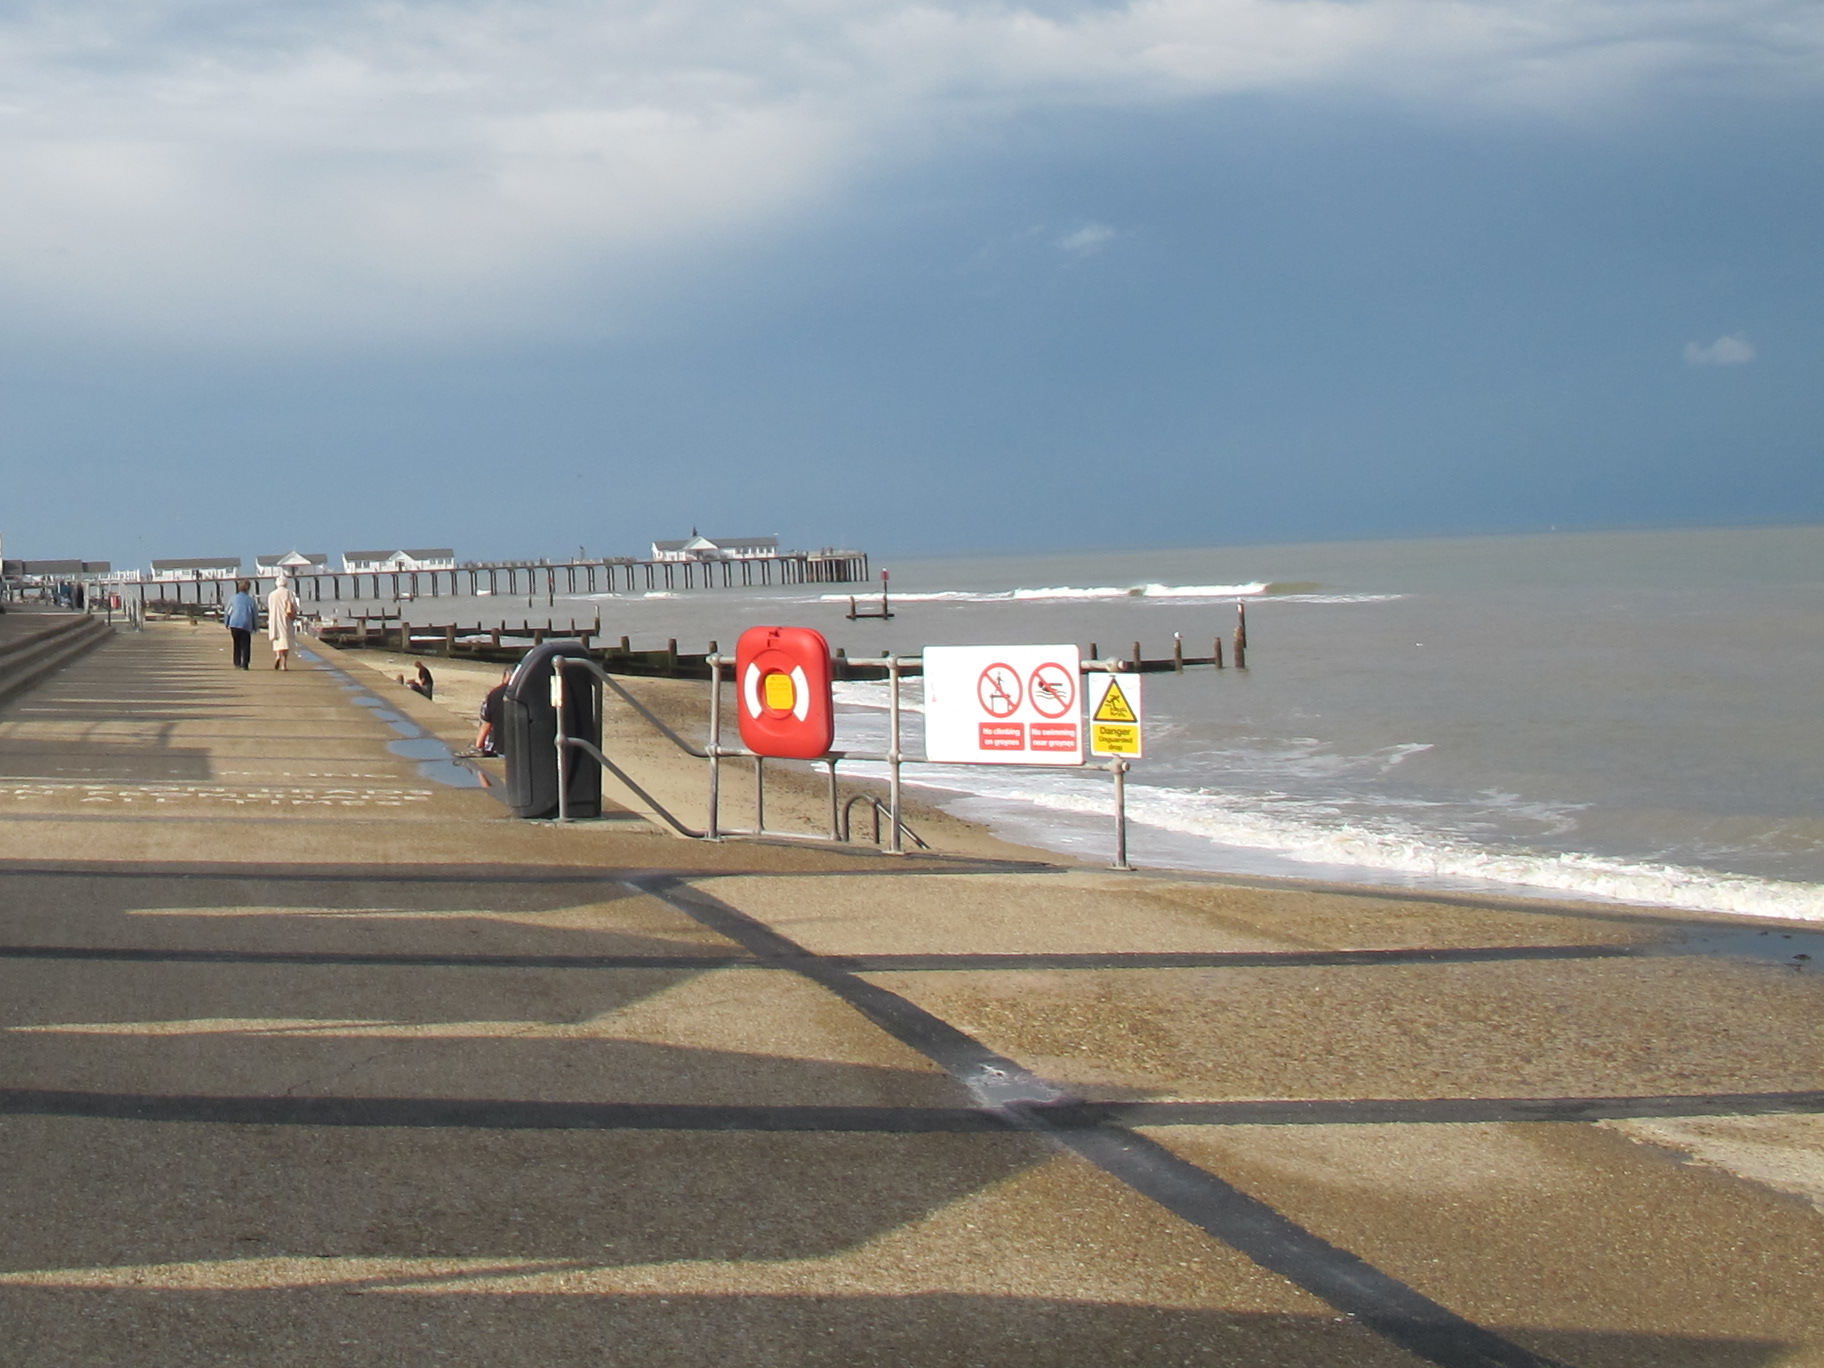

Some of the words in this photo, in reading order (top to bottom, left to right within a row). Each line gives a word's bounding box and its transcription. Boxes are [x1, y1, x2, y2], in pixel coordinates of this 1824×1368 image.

[993, 728, 1021, 737] climbing
[1042, 729, 1075, 737] swimming
[1099, 726, 1131, 737] Danger
[993, 739, 1020, 747] groynes
[1048, 740, 1075, 748] groynes
